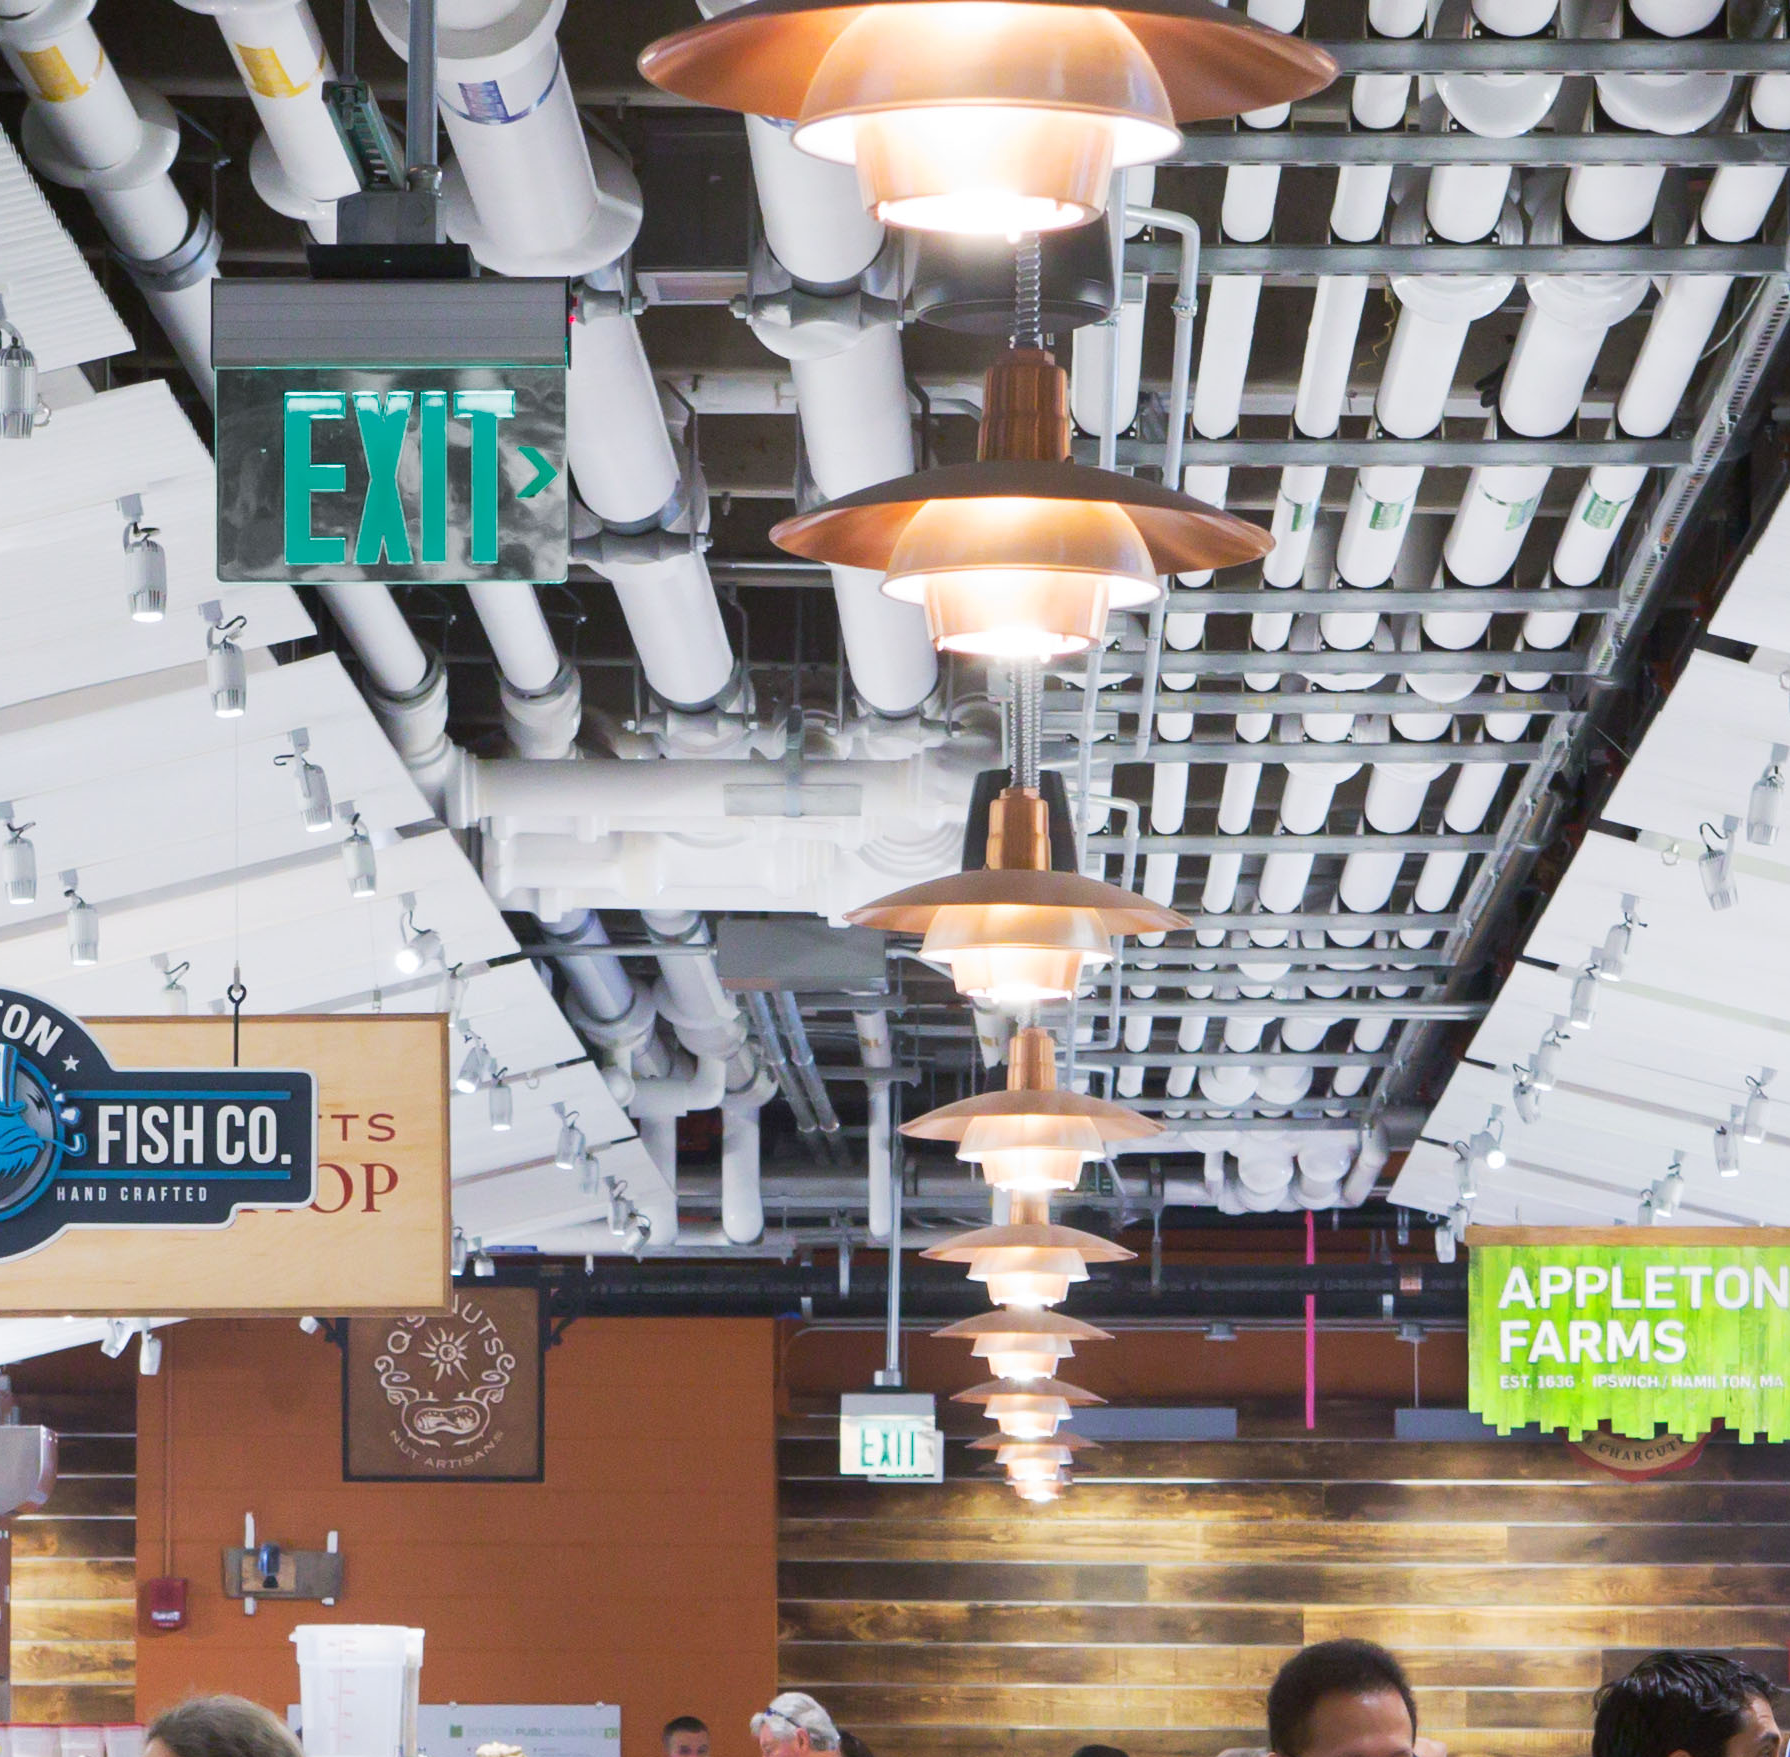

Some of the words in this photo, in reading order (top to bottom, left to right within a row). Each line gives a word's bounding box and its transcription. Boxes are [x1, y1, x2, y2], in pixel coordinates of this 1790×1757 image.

[283, 390, 516, 566] EXIT
[97, 1104, 203, 1166] FISH
[215, 1104, 292, 1166] CO.
[56, 1187, 113, 1203] HAND
[119, 1187, 209, 1204] CRAFTED
[1497, 1265, 1790, 1311] APPLETON
[1498, 1319, 1688, 1363] FARMS
[1500, 1375, 1532, 1389] EST.
[1537, 1375, 1575, 1389] 1636
[1592, 1375, 1659, 1389] IPSWICH
[389, 1429, 421, 1461] NUT
[424, 1430, 504, 1469] ARTISANS
[861, 1421, 925, 1467] EXIT
[515, 1727, 555, 1737] PUBLIC
